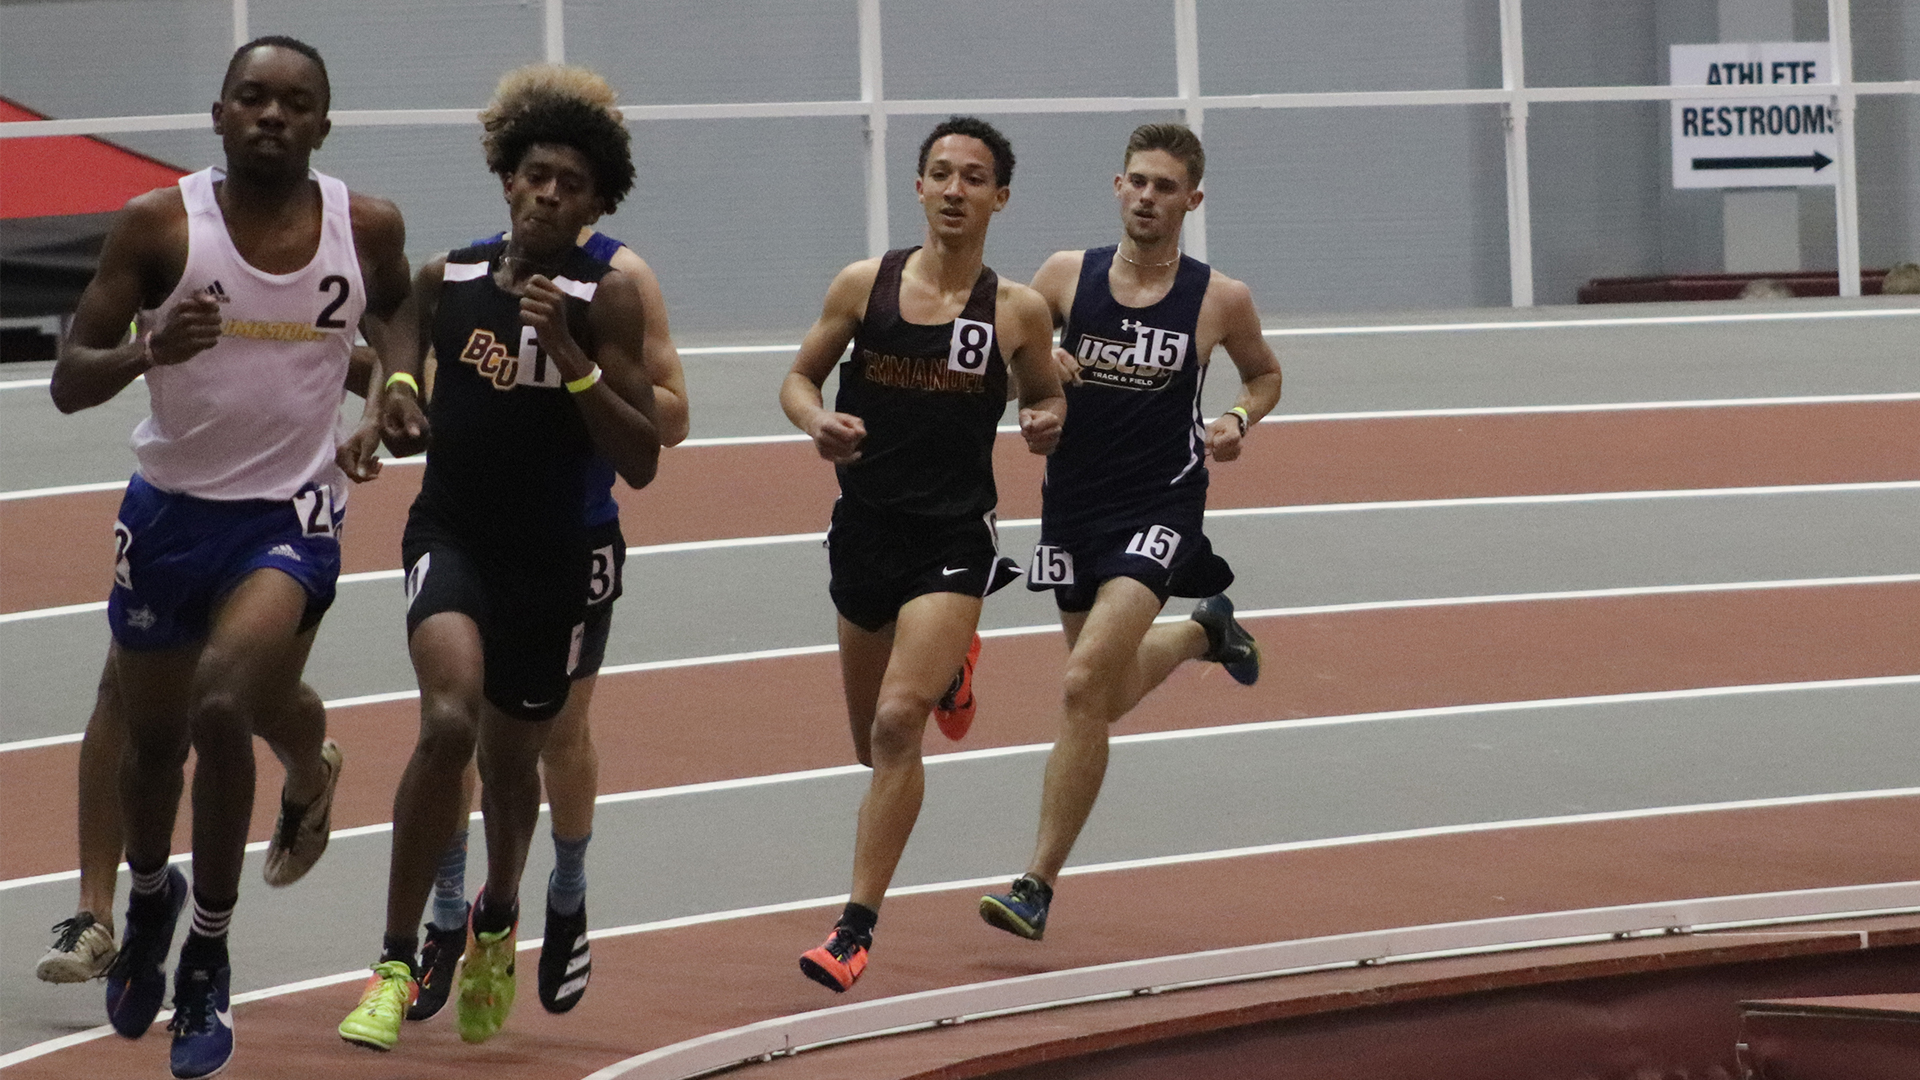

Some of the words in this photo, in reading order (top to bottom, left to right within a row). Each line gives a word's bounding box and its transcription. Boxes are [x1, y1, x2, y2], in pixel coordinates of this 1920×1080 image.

[1707, 61, 1816, 85] ATHLETE
[315, 275, 350, 328] 2
[460, 329, 519, 390] BCU
[527, 338, 548, 382] 1
[957, 323, 988, 370] 8
[1079, 338, 1161, 377] USC
[1141, 329, 1180, 367] 15
[1092, 371, 1119, 381] TRACK
[1129, 377, 1154, 386] FIELD
[296, 488, 330, 534] 2
[1135, 527, 1174, 560] 15
[1035, 546, 1067, 582] 15
